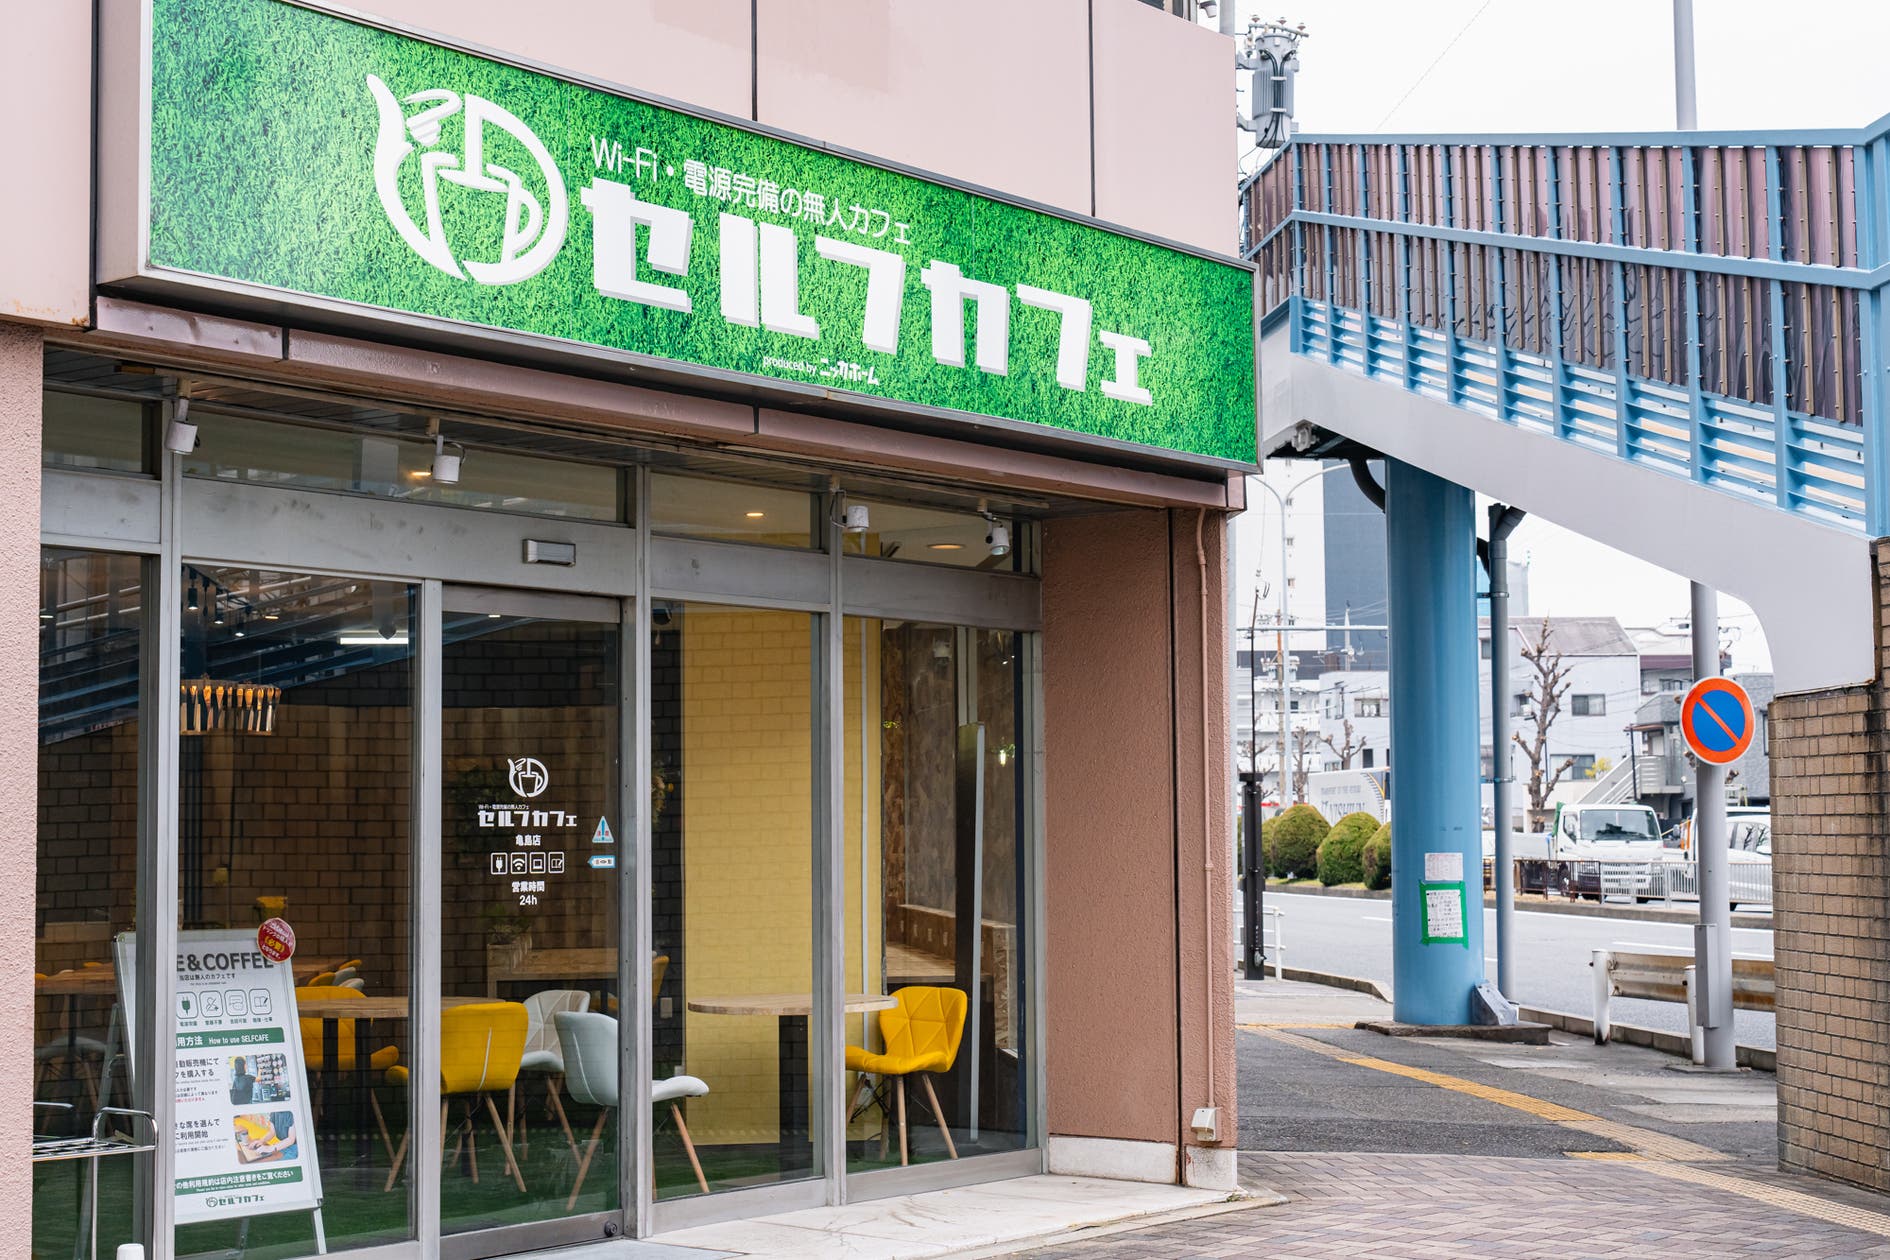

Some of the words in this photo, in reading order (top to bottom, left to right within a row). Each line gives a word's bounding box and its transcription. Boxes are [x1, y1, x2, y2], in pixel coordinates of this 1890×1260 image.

[590, 135, 911, 245] Wi-Fi・電源完備の無人カフェ
[580, 176, 1154, 406] セルフカフェ
[763, 356, 804, 371] produced
[806, 362, 817, 376] by
[819, 358, 879, 386] ニッカホーム
[477, 810, 578, 827] セルフカフェ
[511, 880, 546, 893] 営業時間
[519, 894, 538, 906] 24h
[208, 1036, 221, 1045] How
[223, 1036, 229, 1044] to
[230, 1036, 240, 1044] use
[241, 1034, 269, 1043] SELFCAFE
[219, 1194, 265, 1206] セルフカフェ
